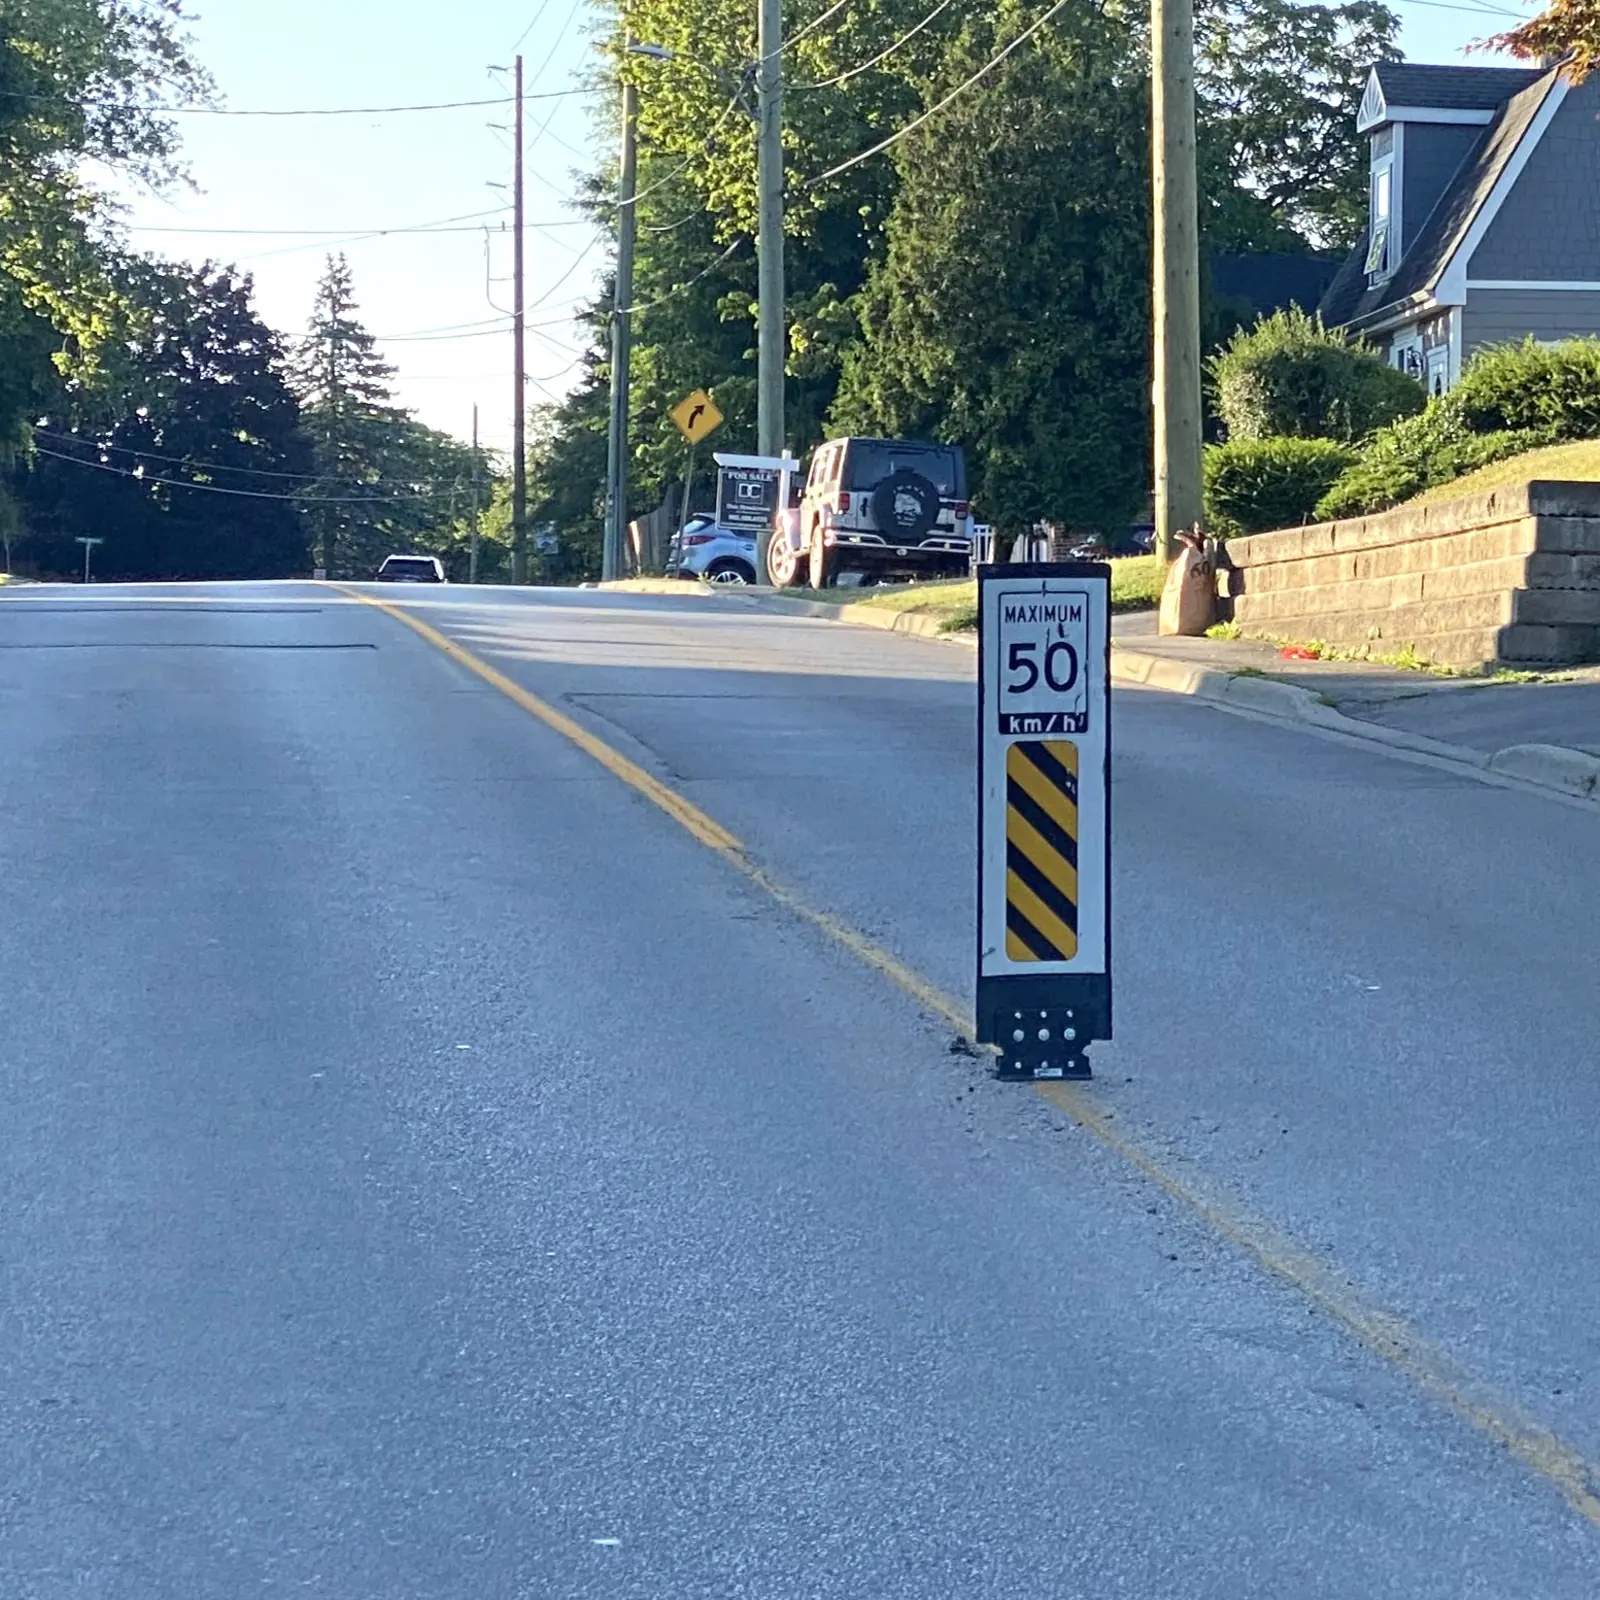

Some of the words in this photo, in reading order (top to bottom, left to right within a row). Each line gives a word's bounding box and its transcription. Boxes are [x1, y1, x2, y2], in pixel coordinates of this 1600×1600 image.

[728, 471, 748, 480] FOR
[749, 473, 773, 482] SALE
[1005, 605, 1081, 623] MAXIMUM
[1007, 641, 1078, 694] 50
[1010, 715, 1075, 733] km/h
